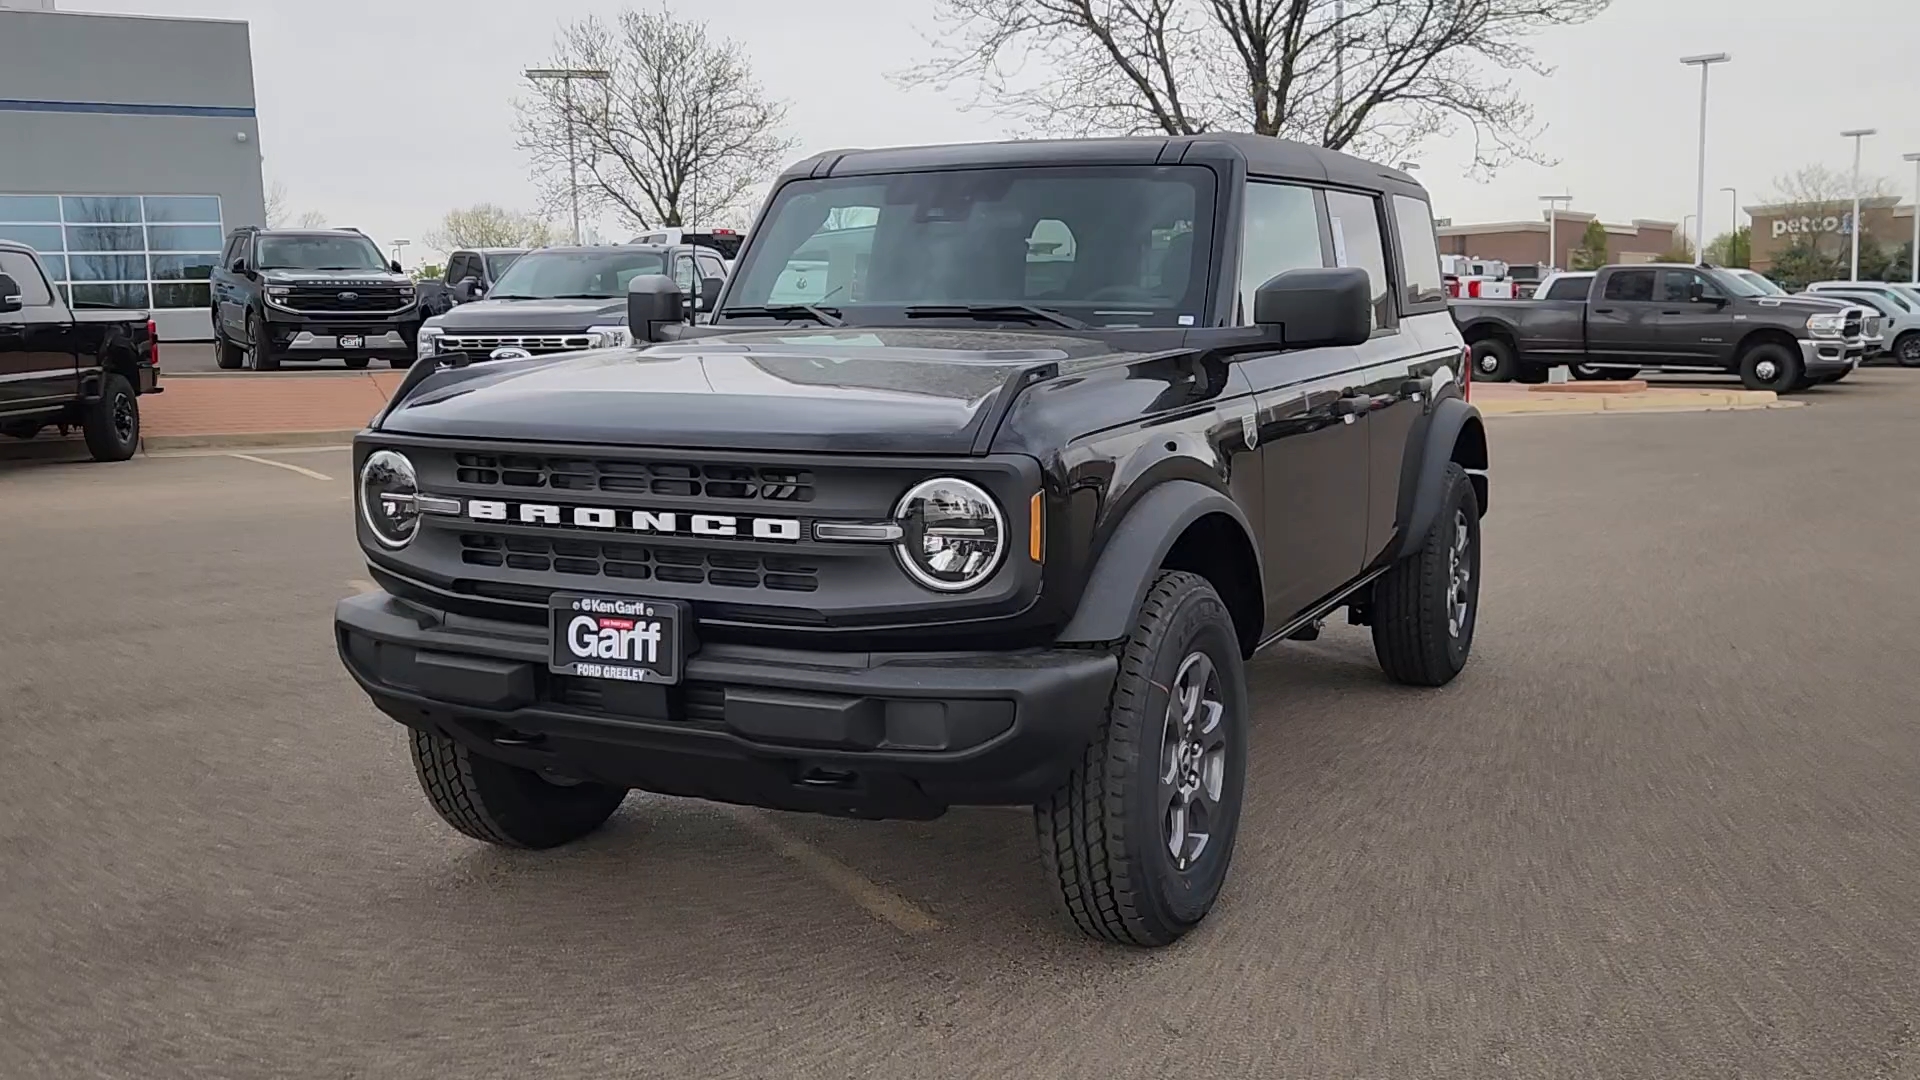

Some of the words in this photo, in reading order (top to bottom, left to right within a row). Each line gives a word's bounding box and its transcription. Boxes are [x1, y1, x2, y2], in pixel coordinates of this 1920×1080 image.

[1772, 216, 1839, 238] petco
[468, 500, 801, 540] BRONCO
[592, 599, 615, 613] Ken
[615, 601, 644, 615] Garff
[568, 615, 661, 662] Garff
[576, 664, 601, 677] FORD
[603, 666, 645, 681] GREELEY
